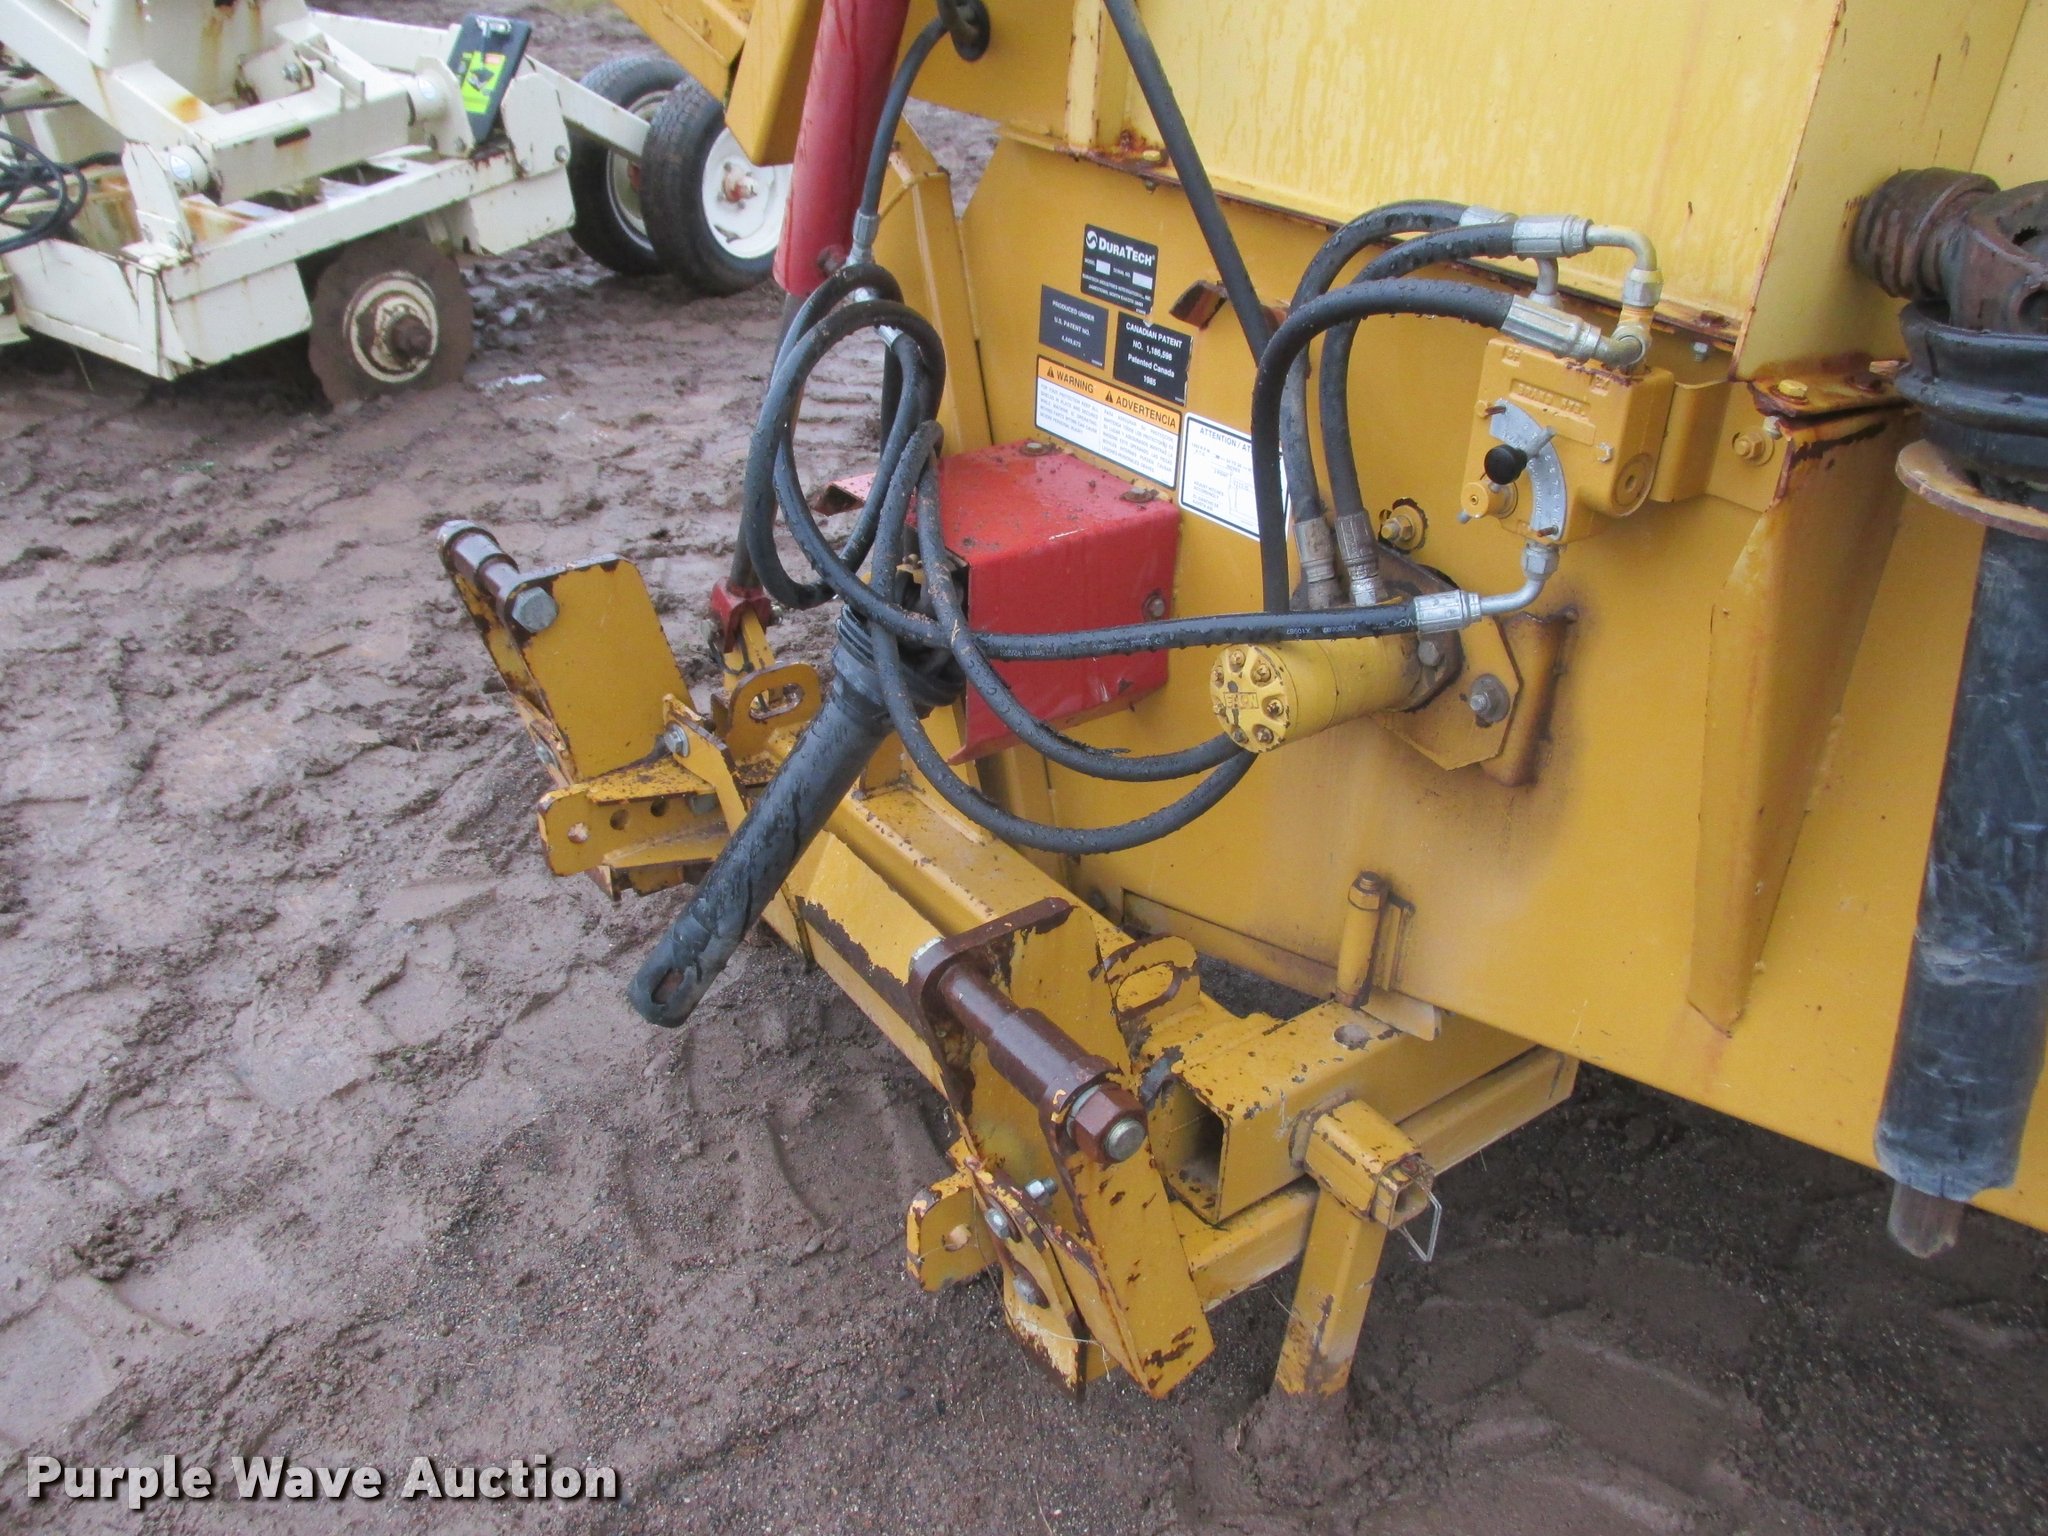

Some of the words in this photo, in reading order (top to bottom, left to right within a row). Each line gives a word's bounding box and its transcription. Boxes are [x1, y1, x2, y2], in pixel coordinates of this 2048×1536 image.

[1099, 237, 1152, 266] DURATECH
[1064, 320, 1081, 332] PATENT
[1126, 322, 1158, 340] CANADIAN
[1158, 333, 1183, 348] PATENT
[1132, 340, 1143, 350] NO.
[1128, 353, 1152, 369] Patented
[1153, 363, 1175, 378] Canada
[1057, 370, 1094, 394] WARNING
[1116, 396, 1176, 429] ADVERTENCIA
[1199, 427, 1237, 447] ATTENTION
